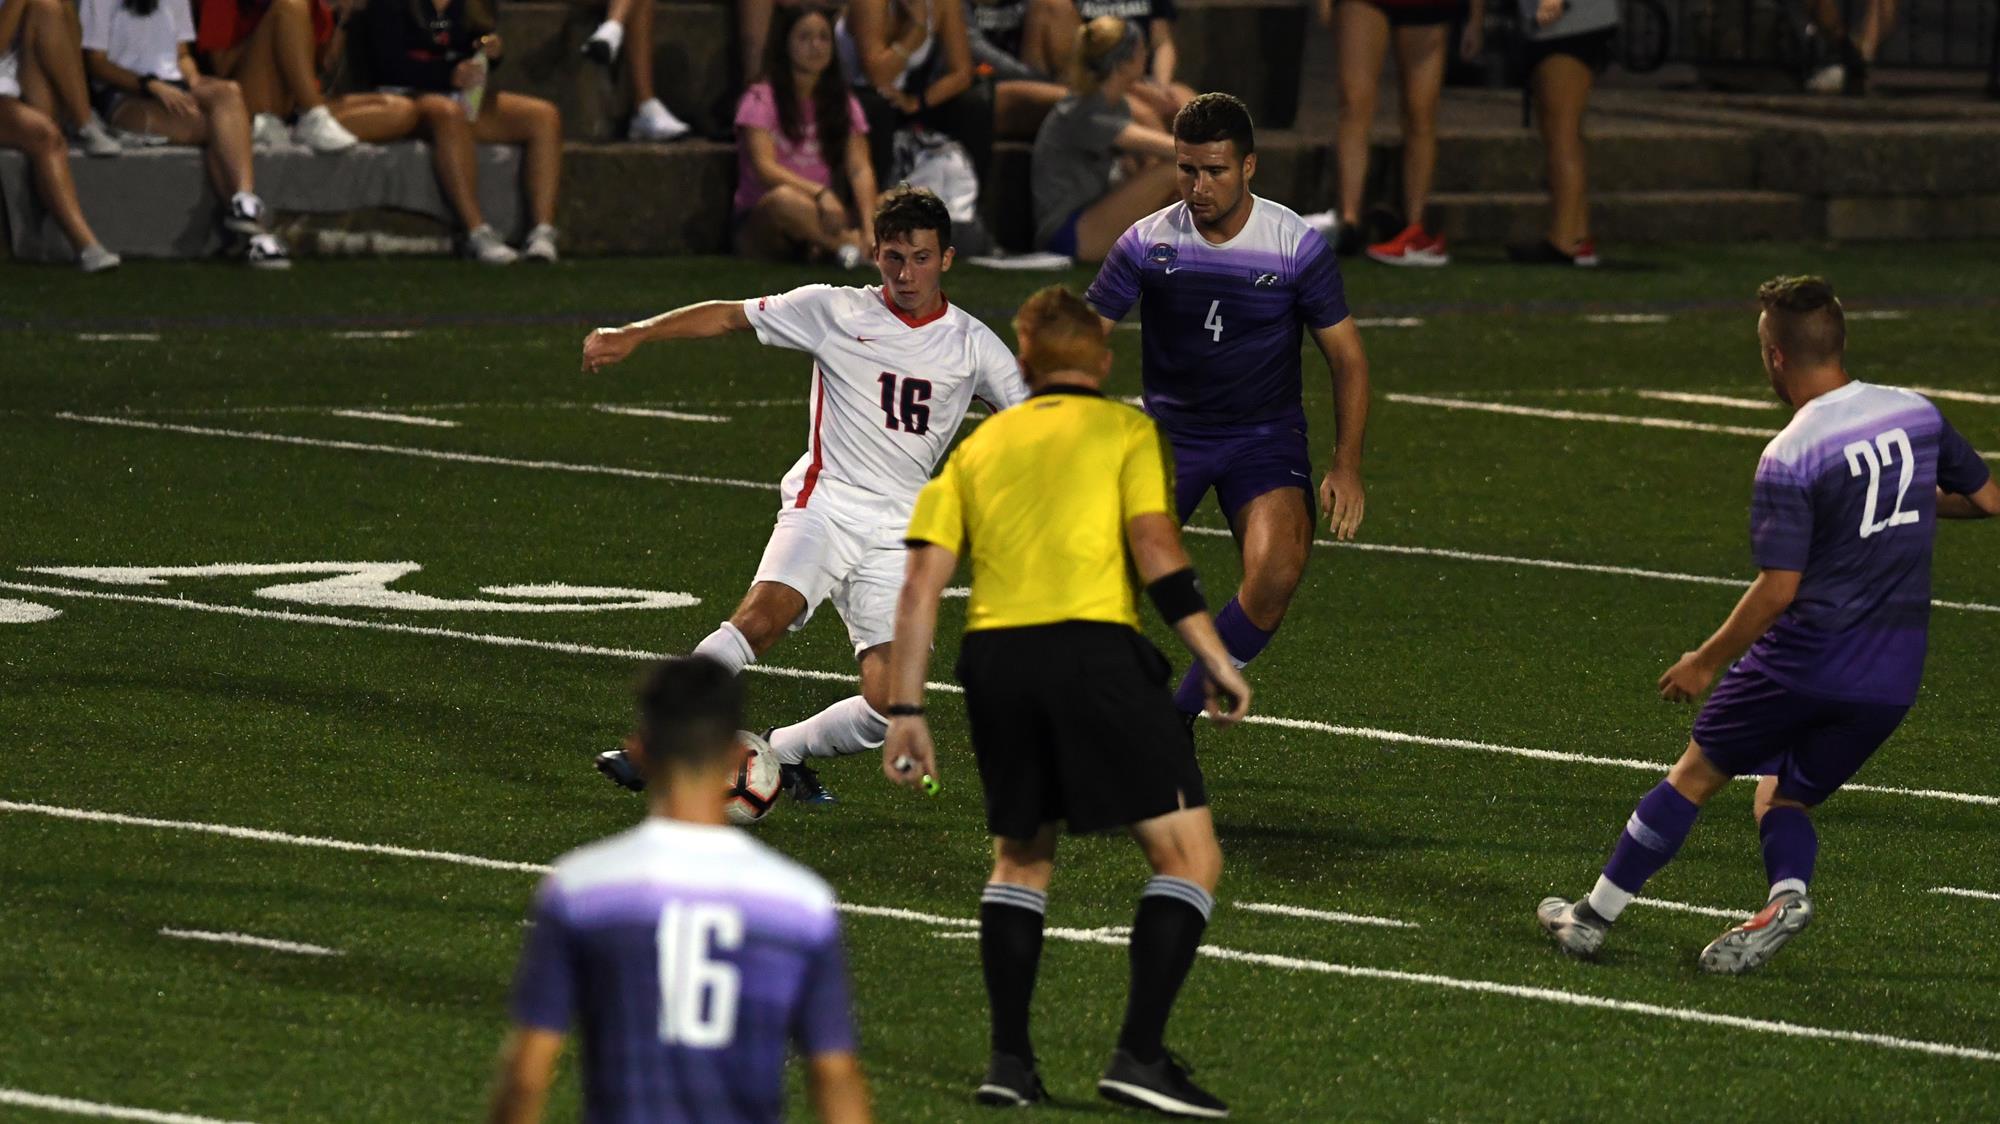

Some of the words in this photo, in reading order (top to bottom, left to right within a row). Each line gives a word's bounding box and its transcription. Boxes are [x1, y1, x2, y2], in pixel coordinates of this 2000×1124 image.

[1203, 299, 1224, 343] 4
[877, 371, 933, 436] 16
[1842, 427, 1920, 539] 22
[655, 899, 745, 1051] 16
